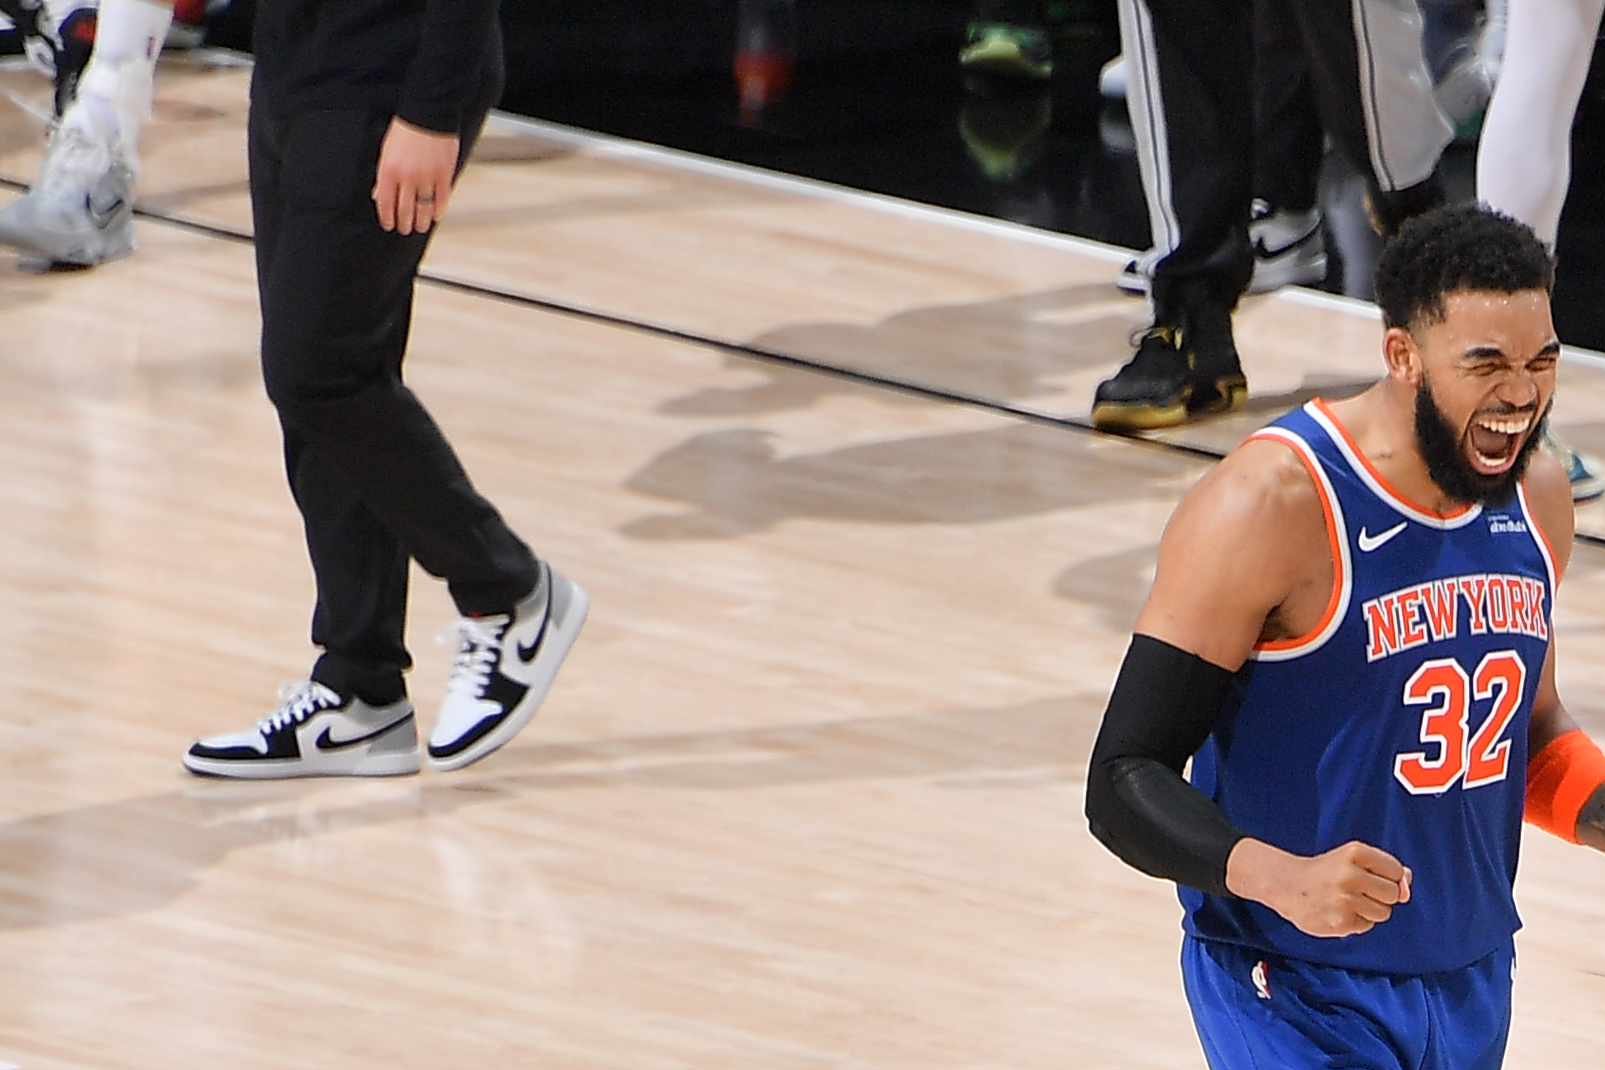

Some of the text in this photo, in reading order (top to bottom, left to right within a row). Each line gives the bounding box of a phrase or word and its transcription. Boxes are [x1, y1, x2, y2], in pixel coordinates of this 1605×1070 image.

[1362, 573, 1548, 663] NEW YORK
[1393, 649, 1526, 795] 32
